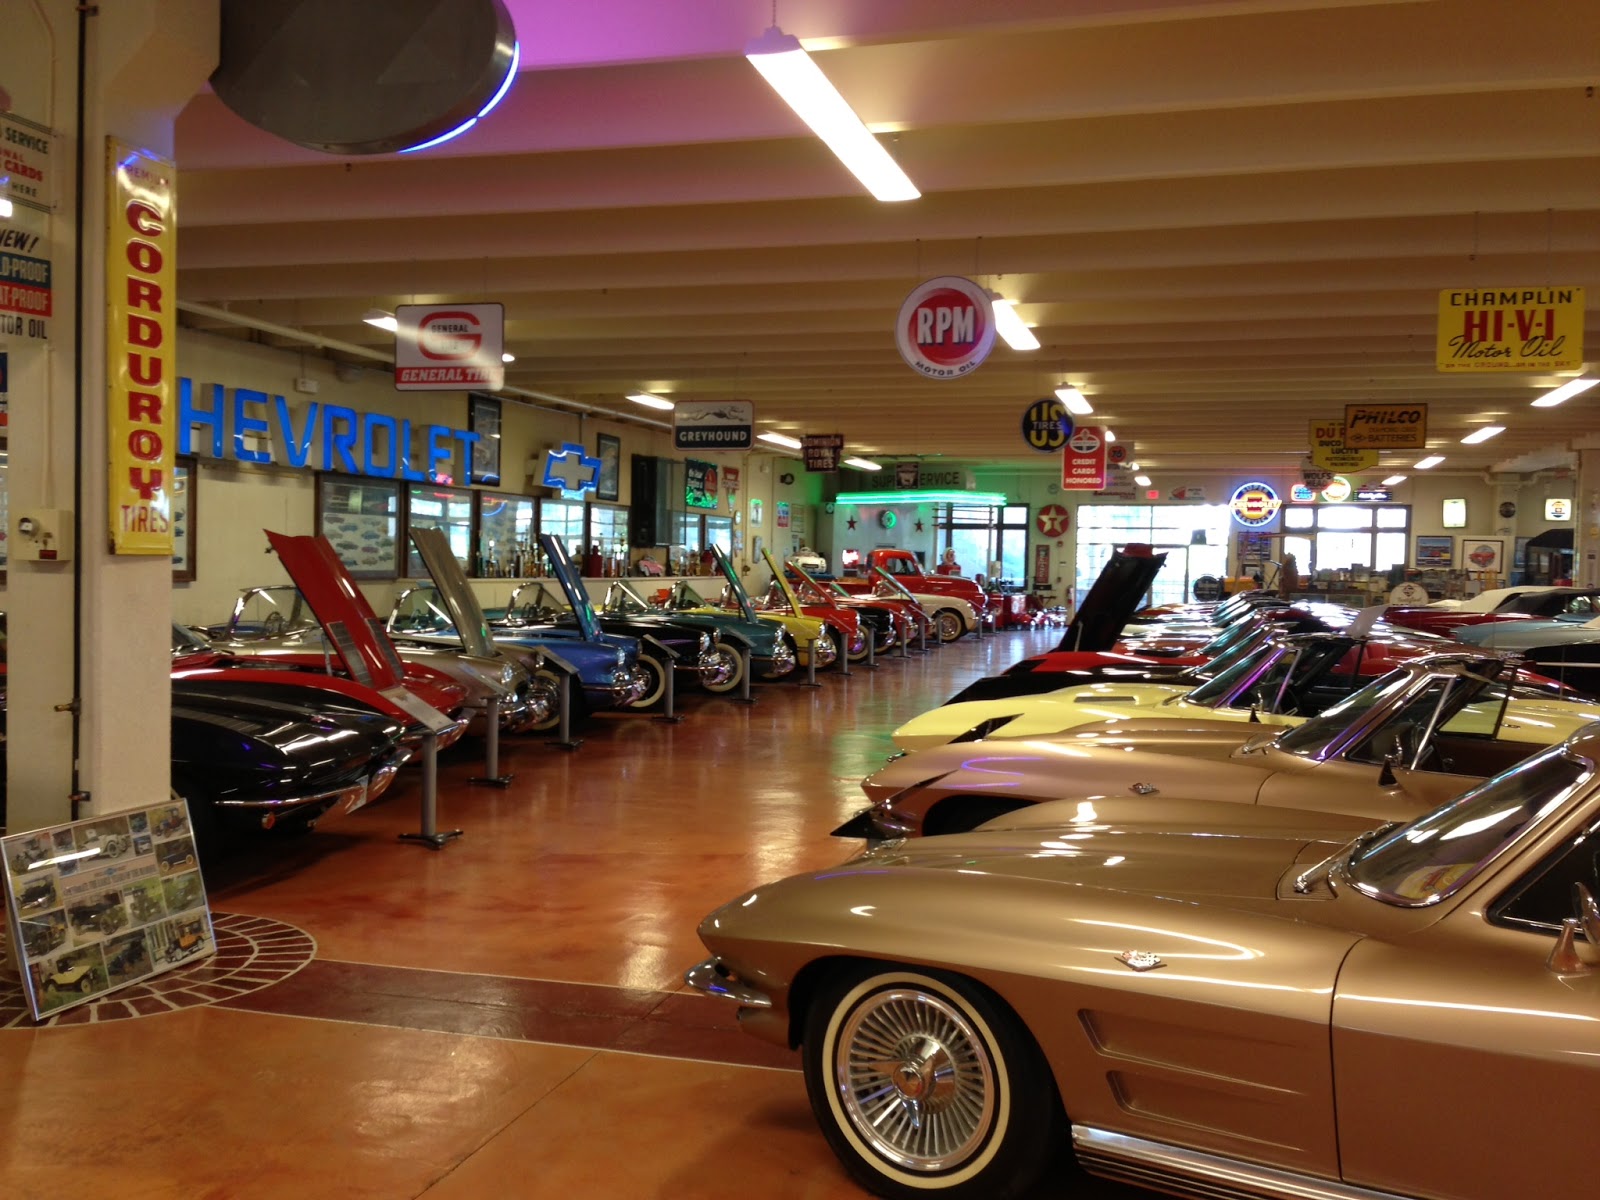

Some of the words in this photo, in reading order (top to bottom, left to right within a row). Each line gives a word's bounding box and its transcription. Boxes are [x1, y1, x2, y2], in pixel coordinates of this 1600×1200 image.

[5, 127, 48, 154] SERVICE
[5, 160, 43, 182] CARDS
[12, 182, 37, 197] HERE
[0, 256, 48, 283] D-PROOF
[1451, 291, 1572, 306] CHAMPLIN
[0, 314, 23, 336] TOR
[28, 319, 48, 340] OIL
[431, 324, 469, 333] GENERAL
[917, 306, 974, 344] RPM
[126, 199, 164, 500] CORDUROY
[1448, 335, 1512, 358] Motor
[1520, 335, 1566, 357] Oil
[402, 369, 462, 382] GENERAL
[466, 368, 495, 381] TIR
[915, 361, 954, 376] MOTOR
[958, 361, 976, 373] OIL
[1032, 421, 1063, 430] TIRES
[1350, 409, 1421, 428] PHILCO
[177, 377, 480, 487] HEVROLET
[679, 431, 747, 441] GREYHOUND
[808, 448, 834, 457] ROYAL
[808, 459, 834, 469] TIRES
[872, 474, 896, 488] SUP
[920, 472, 960, 487] ERVICE
[121, 504, 169, 533] TIRES
